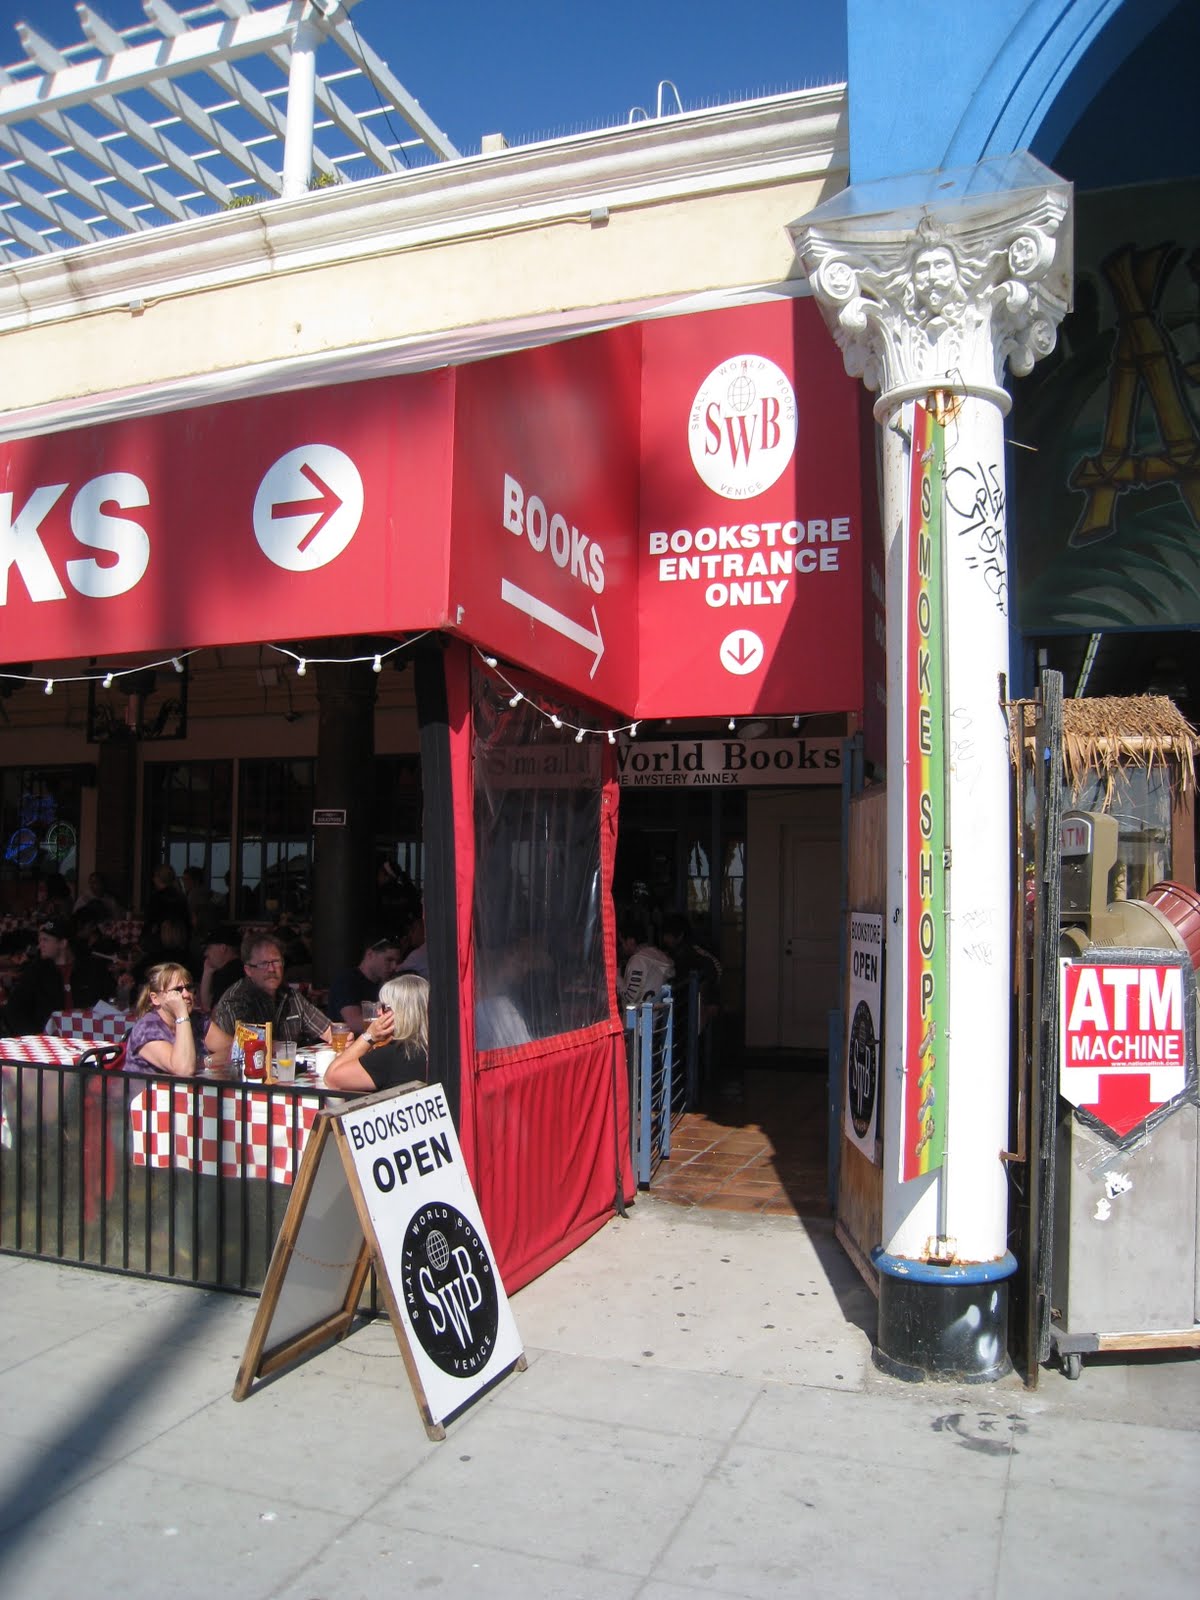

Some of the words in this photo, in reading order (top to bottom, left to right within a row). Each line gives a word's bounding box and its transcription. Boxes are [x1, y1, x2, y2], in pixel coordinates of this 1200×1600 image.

[691, 390, 709, 430] SMALL
[718, 359, 767, 376] WORLD
[776, 378, 795, 421] BOOKS
[705, 396, 781, 468] SWB
[720, 481, 763, 496] VENICE
[0, 472, 150, 606] KS
[503, 473, 604, 594] BOOKS
[649, 517, 850, 554] BOOKSTORE
[658, 547, 839, 581] ENTRANCE
[705, 580, 788, 607] ONLY
[917, 474, 932, 754] SMOKE
[634, 774, 688, 785] MYSTERY
[693, 773, 739, 784] ANNEX
[722, 741, 841, 770] Books
[852, 921, 880, 944] BOOKSTORE
[918, 792, 934, 1020] SHOP
[854, 950, 878, 983] OPEN
[1068, 968, 1182, 1031] ATM
[1071, 1034, 1180, 1061] MACHINE
[350, 1094, 447, 1150] BOOKSTORE
[372, 1131, 453, 1193] OPEN
[405, 1250, 419, 1320] SMALL
[412, 1208, 448, 1235] WORLD
[457, 1217, 489, 1273] BOOKS
[419, 1245, 482, 1350] SWB
[454, 1335, 491, 1370] VENICE
